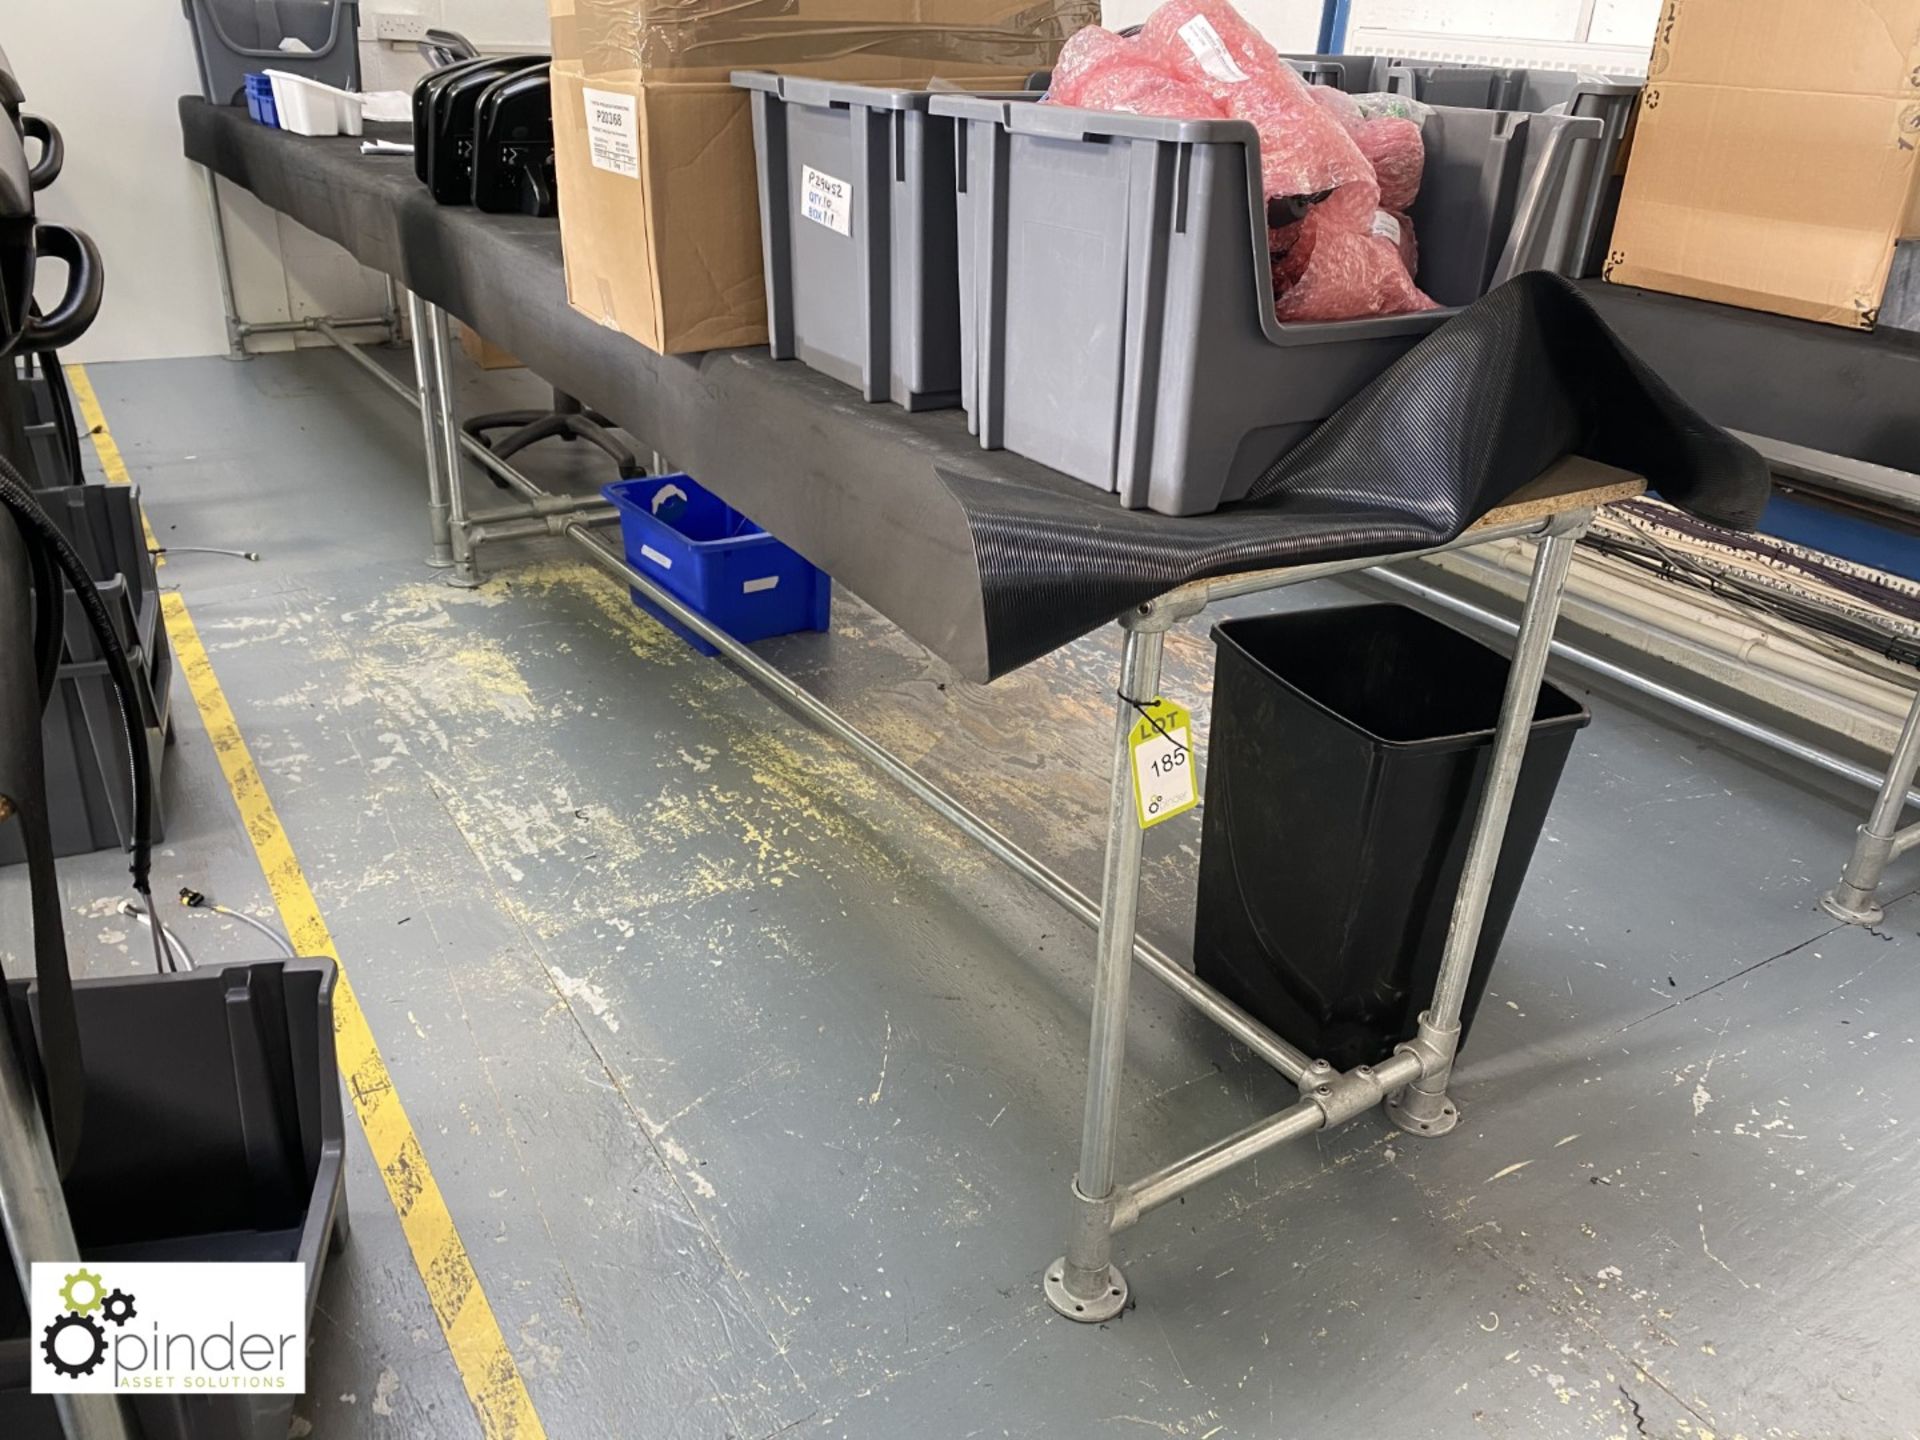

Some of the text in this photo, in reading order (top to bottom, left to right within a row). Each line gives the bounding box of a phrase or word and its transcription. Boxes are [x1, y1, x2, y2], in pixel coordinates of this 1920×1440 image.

[597, 109, 622, 127] P20368
[1140, 711, 1178, 740] LOT
[1151, 746, 1185, 777] 185
